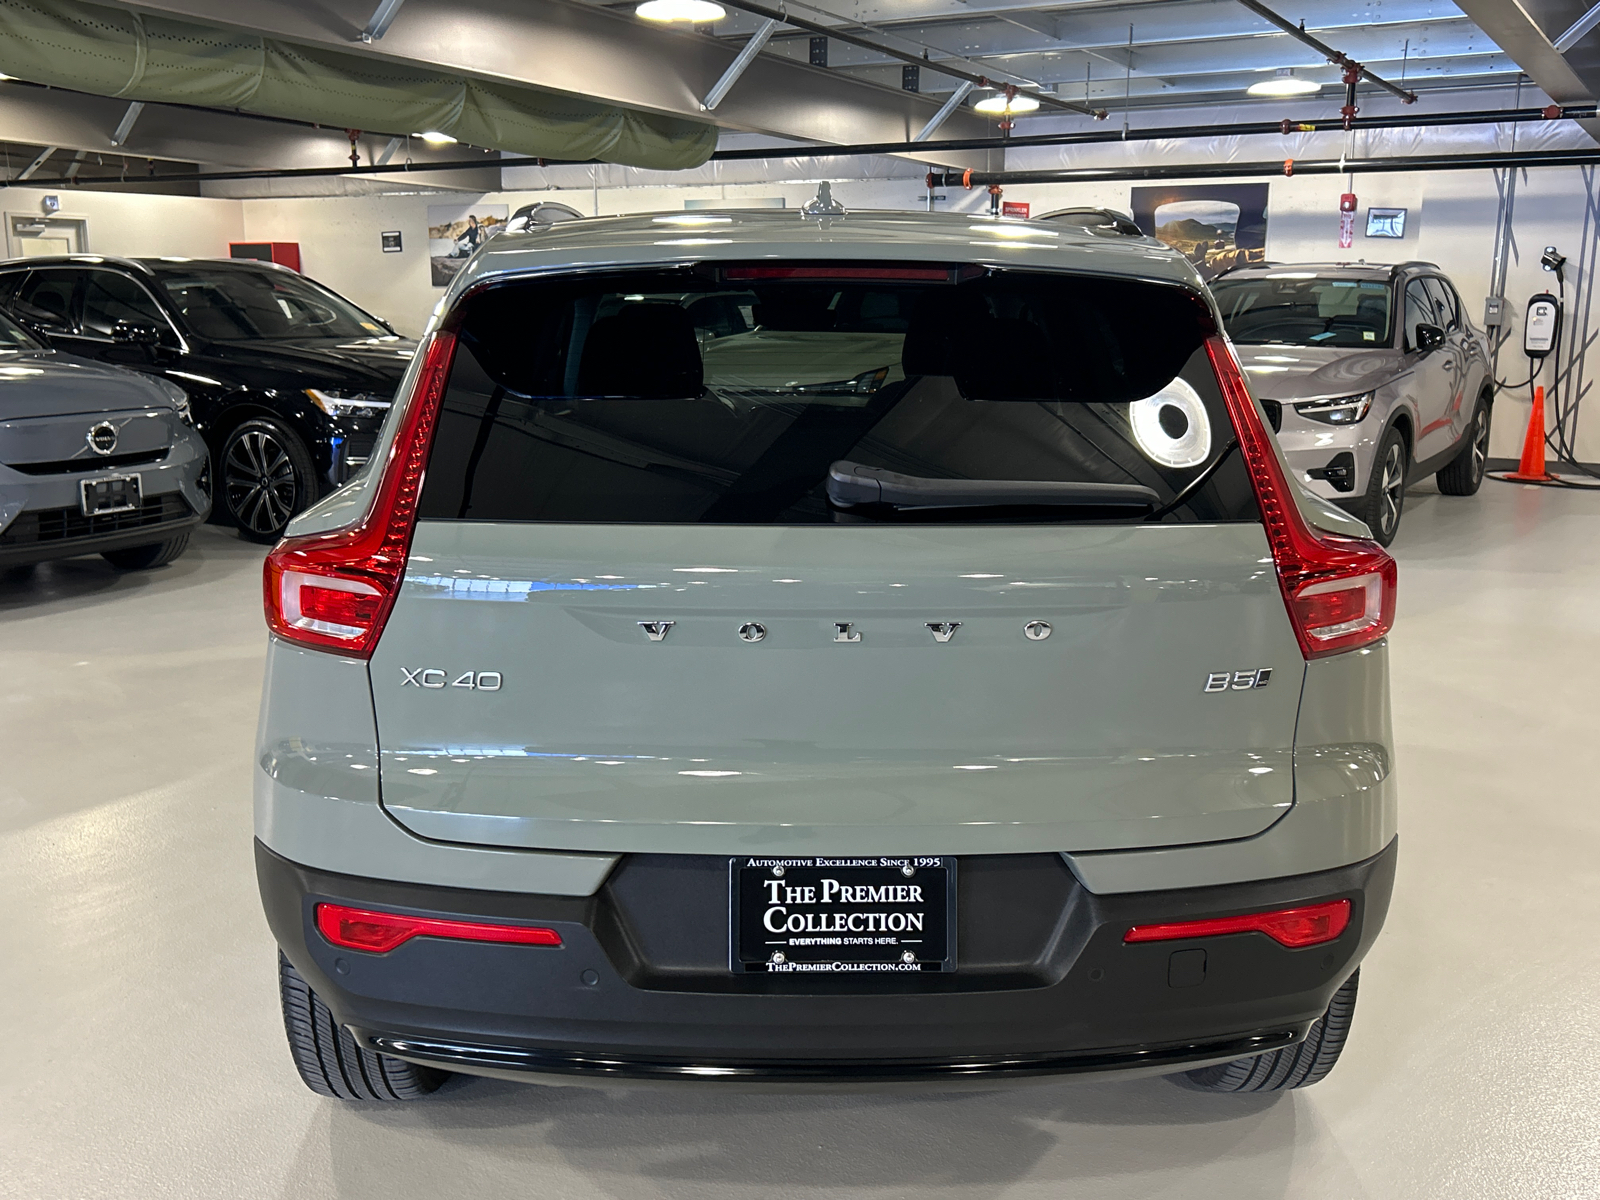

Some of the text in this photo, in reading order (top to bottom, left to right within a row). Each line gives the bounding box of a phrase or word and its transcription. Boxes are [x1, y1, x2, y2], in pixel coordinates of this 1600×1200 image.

[637, 620, 1053, 642] VOLVO
[747, 857, 941, 868] AUTOMOTIVE EXCELLENCE SINCE 1995
[763, 879, 924, 904] THE PREMIER
[763, 906, 924, 933] COLLECTION
[789, 938, 842, 946] EVERYTHING
[874, 937, 899, 945] HERE.
